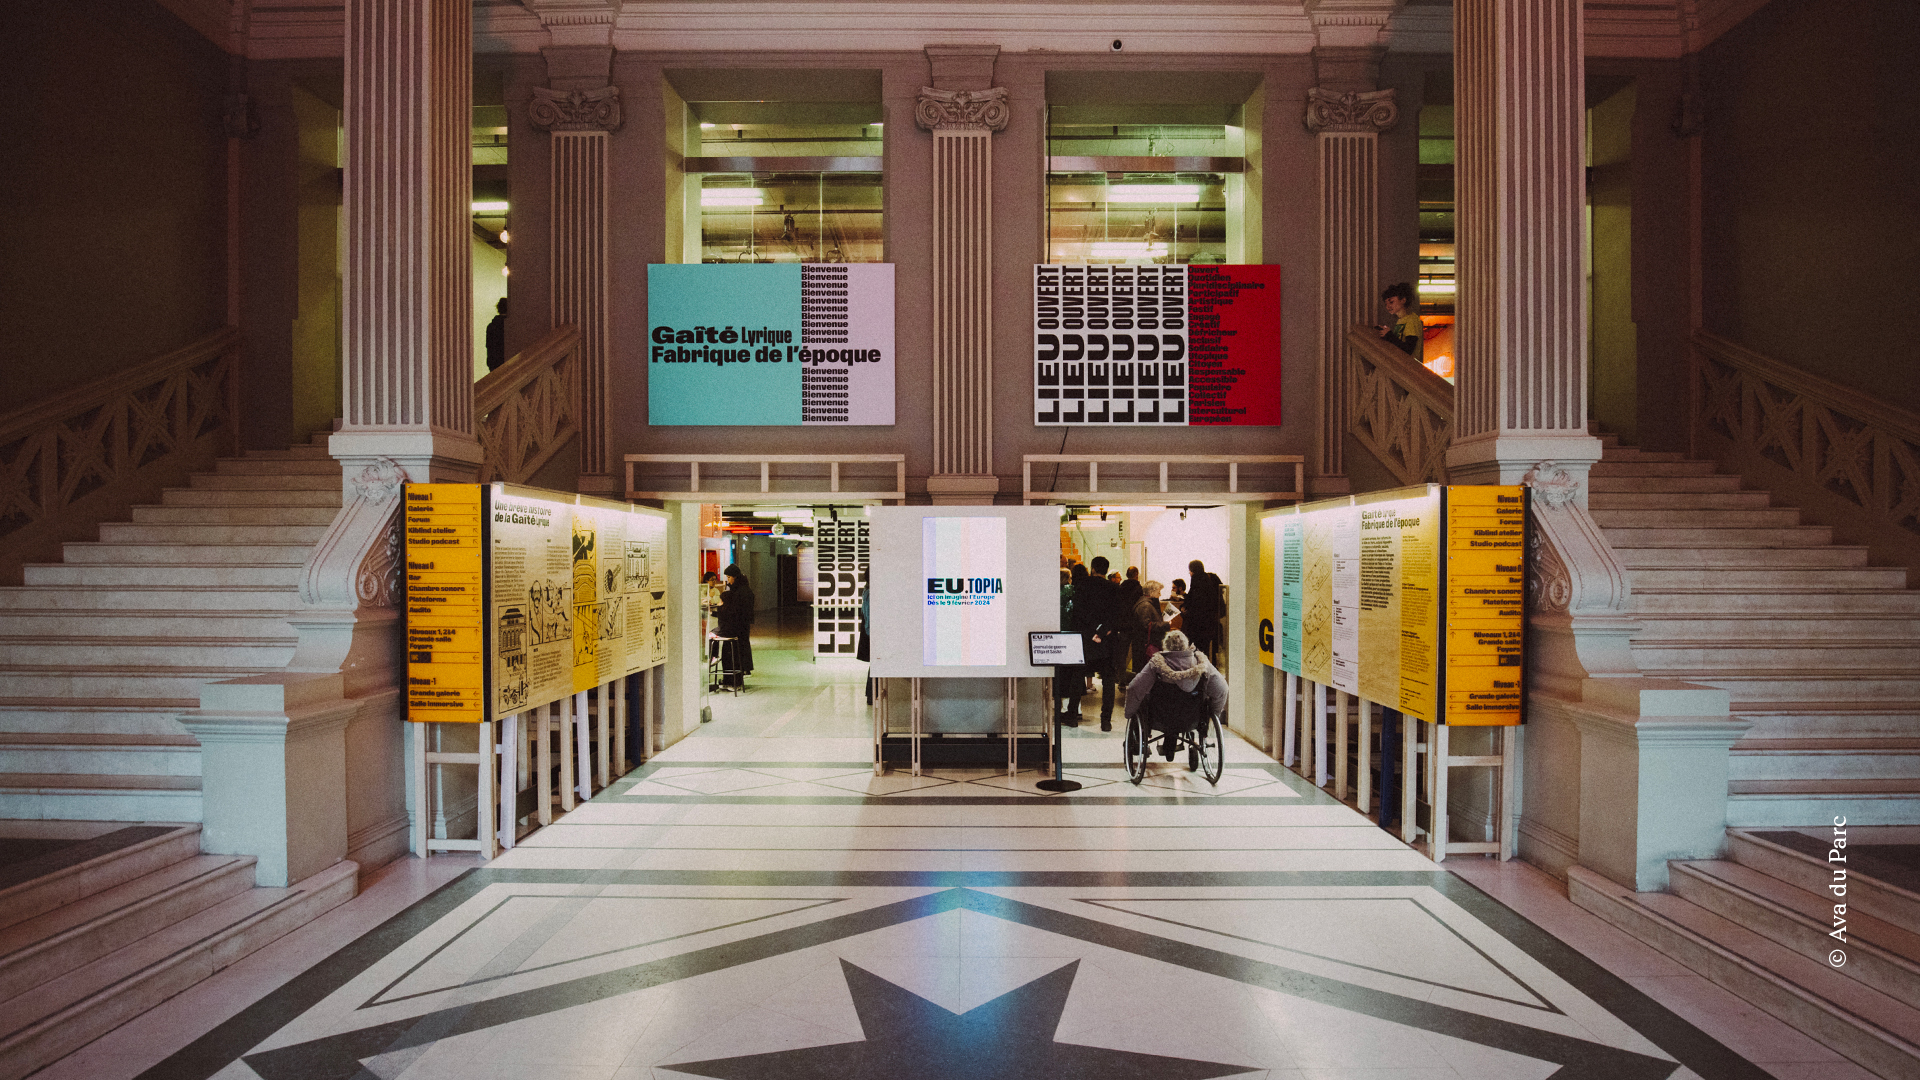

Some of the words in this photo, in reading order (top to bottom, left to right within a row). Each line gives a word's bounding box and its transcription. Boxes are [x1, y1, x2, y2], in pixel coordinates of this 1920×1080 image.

[1038, 266, 1059, 329] OUVERT
[1063, 266, 1084, 329] OUVERT
[1087, 266, 1109, 329] OUVERT
[1112, 266, 1134, 329] OUVERT
[1137, 266, 1159, 329] OUVERT
[1162, 266, 1184, 329] OUVERT
[1188, 282, 1265, 290] Pluridisciplinaire
[1188, 290, 1238, 298] Participatif
[1188, 298, 1233, 306] Artistique
[1188, 313, 1220, 321] Engagé
[652, 326, 739, 344] Gaîté
[742, 327, 792, 347] Lyrique
[652, 345, 750, 366] Fabrique
[755, 346, 782, 363] de
[1188, 353, 1228, 361] Utopique
[1188, 360, 1222, 368] Citoyen
[1188, 368, 1245, 376] Responsable
[1038, 334, 1059, 422] LIEU
[1063, 334, 1084, 422] LIEU
[1087, 334, 1109, 422] LIEU
[1112, 334, 1134, 422] LIEU
[1137, 334, 1159, 422] LIEU
[1163, 334, 1184, 422] LIEU
[1188, 384, 1231, 392] Populaire
[802, 414, 849, 422] Bienvenue
[1188, 415, 1231, 423] Européen
[495, 500, 507, 511] Une
[1498, 495, 1518, 503] Niveau
[495, 512, 503, 522] de
[504, 513, 510, 523] la
[1362, 520, 1385, 530] Fabrique
[1386, 519, 1393, 528] de
[818, 520, 835, 571] OUVERT
[838, 520, 855, 571] OUVERT
[818, 573, 835, 653] LIEU
[838, 573, 855, 653] LIEU
